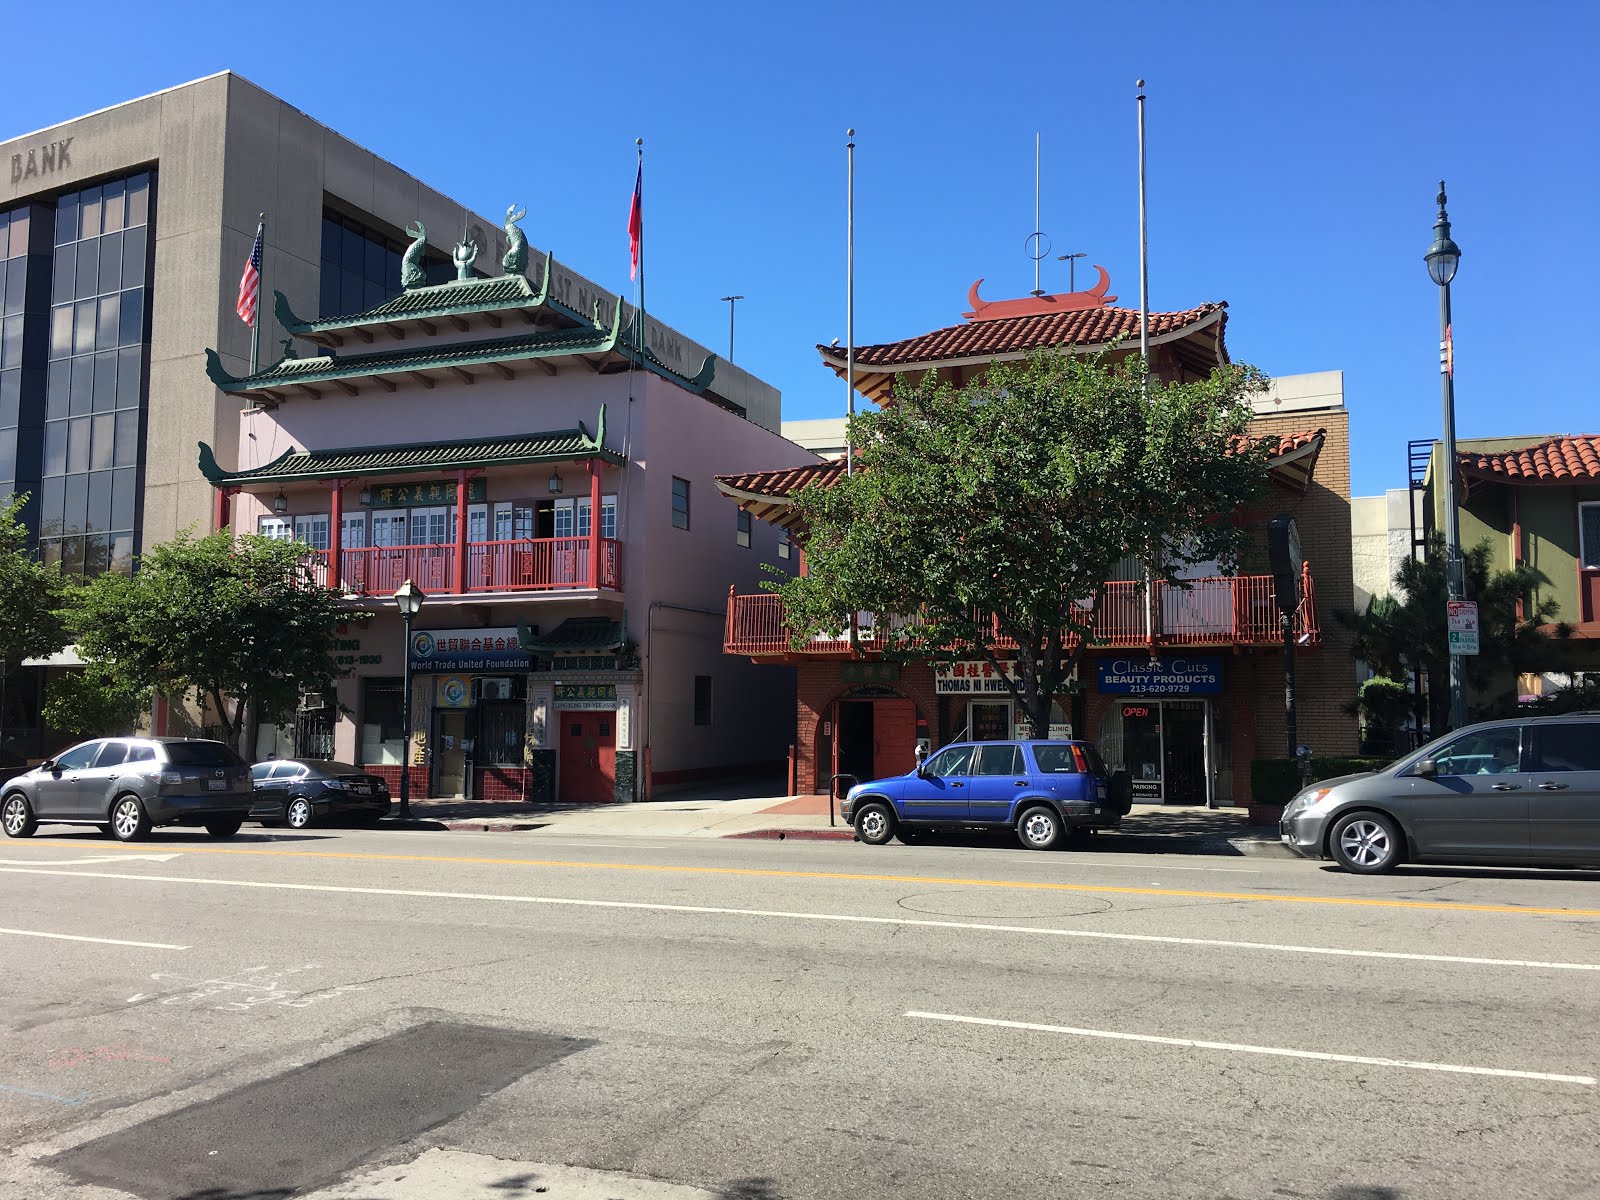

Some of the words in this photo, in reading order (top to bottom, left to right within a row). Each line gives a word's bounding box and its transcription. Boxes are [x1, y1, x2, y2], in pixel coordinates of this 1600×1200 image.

[11, 137, 75, 184] BANK
[651, 326, 682, 362] BANK
[1449, 608, 1458, 616] NO
[1452, 633, 1457, 642] 2
[410, 661, 432, 670] World
[434, 661, 456, 669] Trade
[458, 660, 484, 669] United
[486, 659, 529, 668] Foundation
[1112, 660, 1164, 675] Classic
[1171, 659, 1208, 674] Cuts
[1105, 675, 1150, 684] BEAUTY
[1153, 675, 1216, 683] PRODUCTS
[937, 679, 970, 692] THOMAS
[973, 679, 981, 692] NI
[1130, 685, 1190, 693] 213-620-9729
[1123, 707, 1149, 717] OPEN
